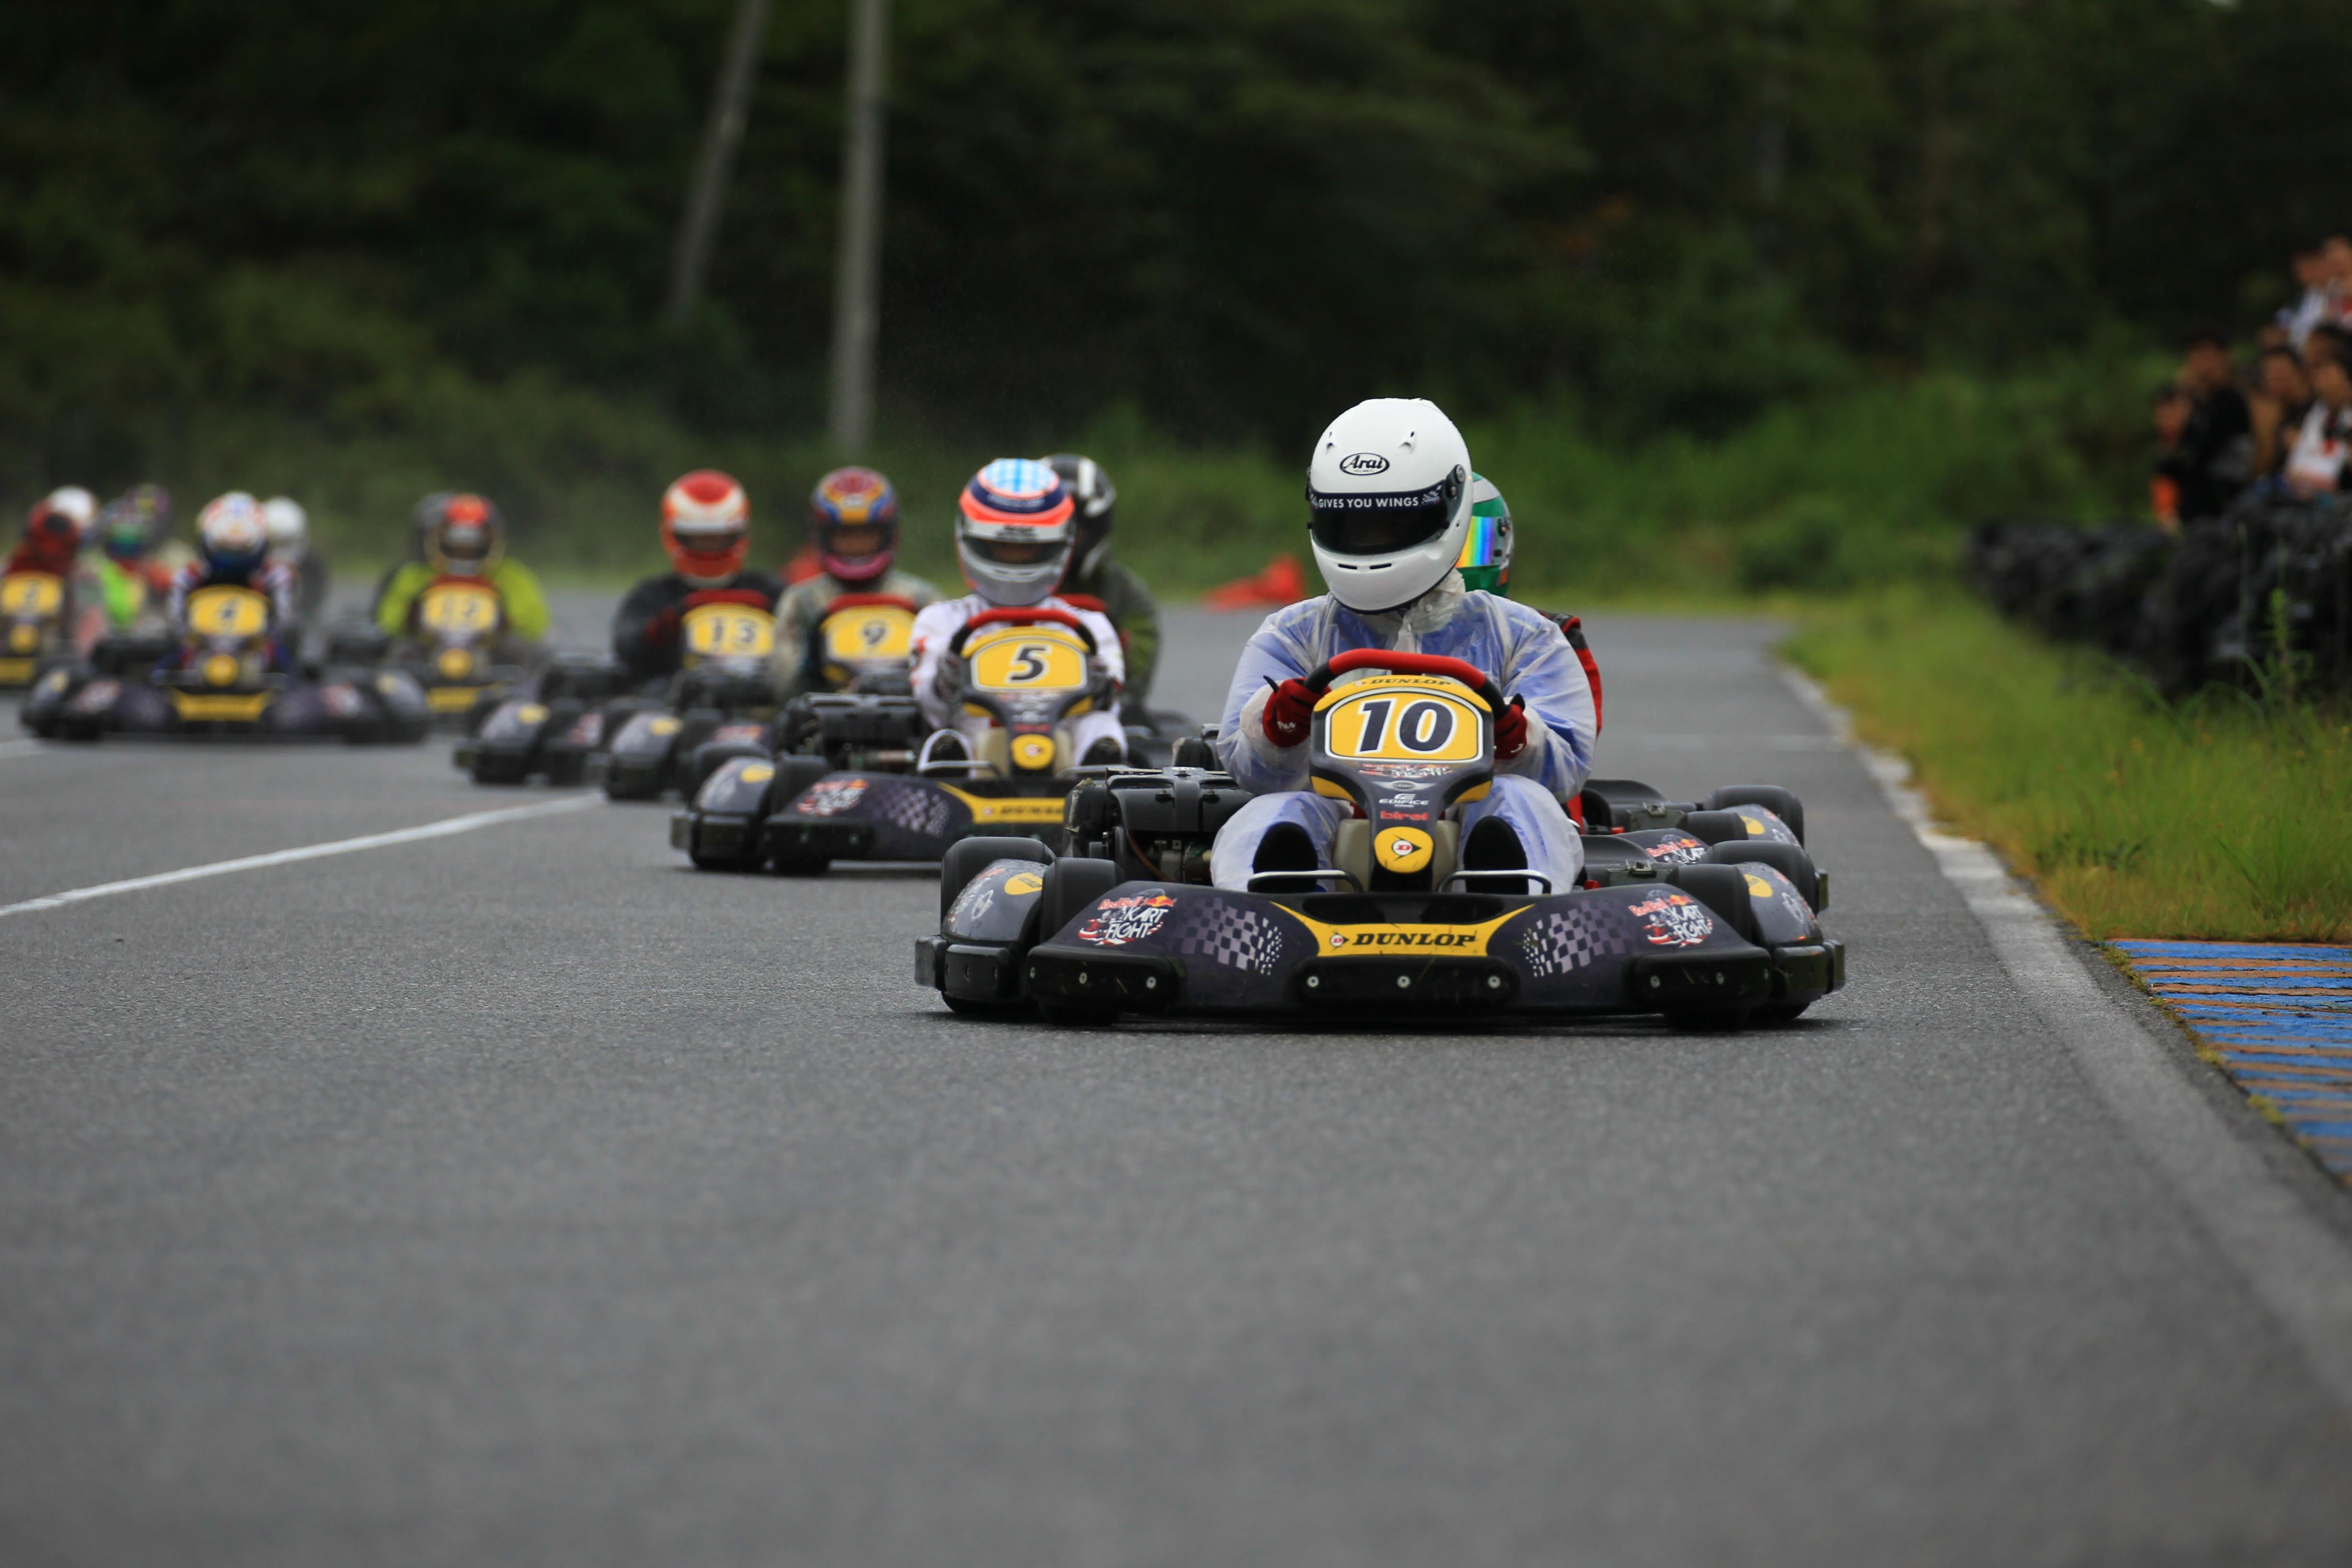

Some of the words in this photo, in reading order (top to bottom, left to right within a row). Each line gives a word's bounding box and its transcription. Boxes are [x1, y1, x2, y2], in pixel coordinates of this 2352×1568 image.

[1343, 455, 1384, 469] Arai
[1318, 499, 1344, 508] GIVES
[1347, 498, 1372, 508] YOU
[1375, 497, 1419, 507] WINGS
[861, 618, 887, 647] 9
[1007, 644, 1050, 683] 5
[1355, 698, 1457, 755] 10
[1123, 906, 1169, 923] KART
[1666, 905, 1705, 922] KART
[1104, 922, 1153, 939] FIGHT
[1672, 919, 1712, 941] FIGHT
[1352, 933, 1476, 947] DUNLOP
